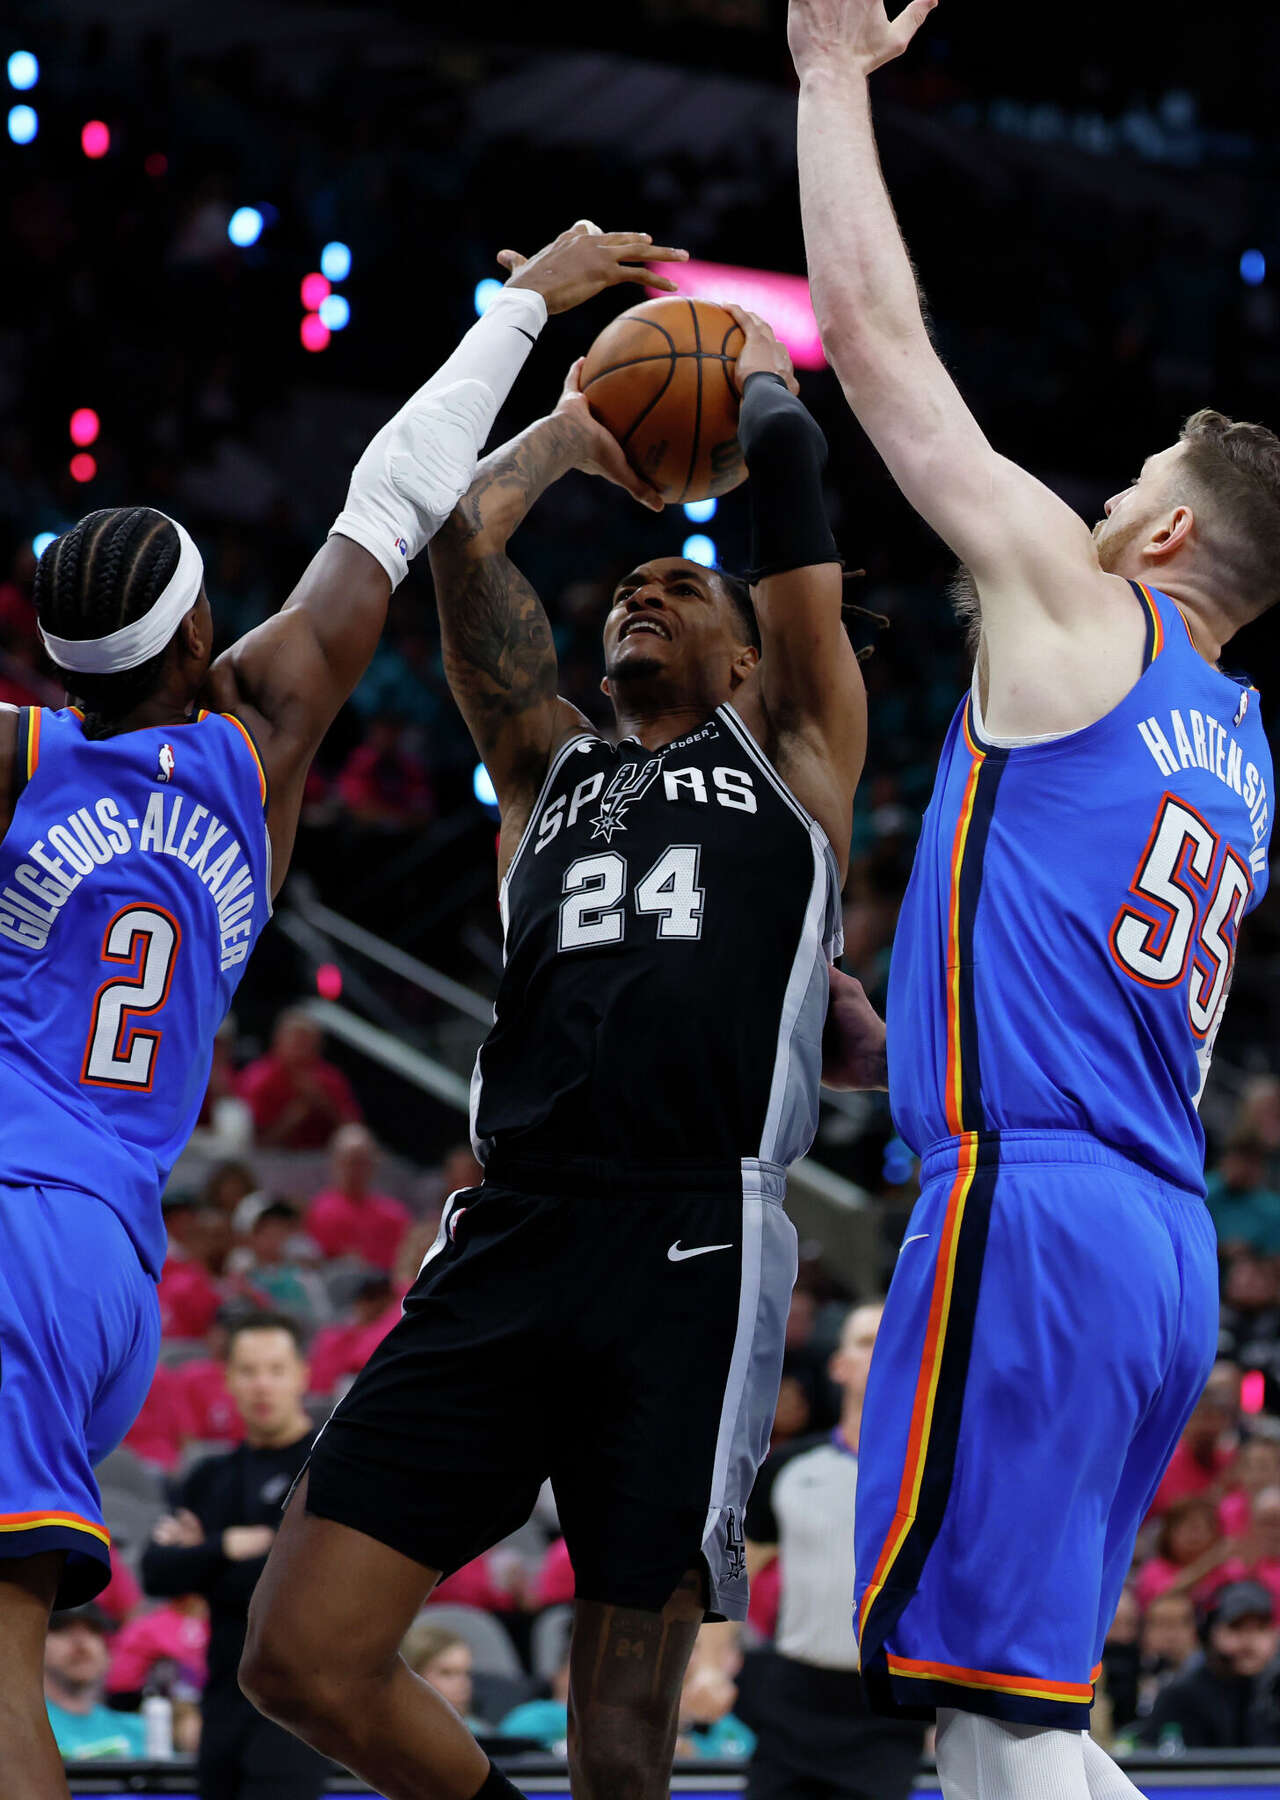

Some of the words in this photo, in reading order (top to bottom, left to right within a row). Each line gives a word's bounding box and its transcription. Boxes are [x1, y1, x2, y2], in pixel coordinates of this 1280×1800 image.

[0, 792, 254, 972] GILGEOUS-ALEXANDER
[535, 759, 758, 854] SPURS
[557, 844, 706, 953] 24
[1108, 791, 1254, 1040] 55
[80, 902, 182, 1092] 2
